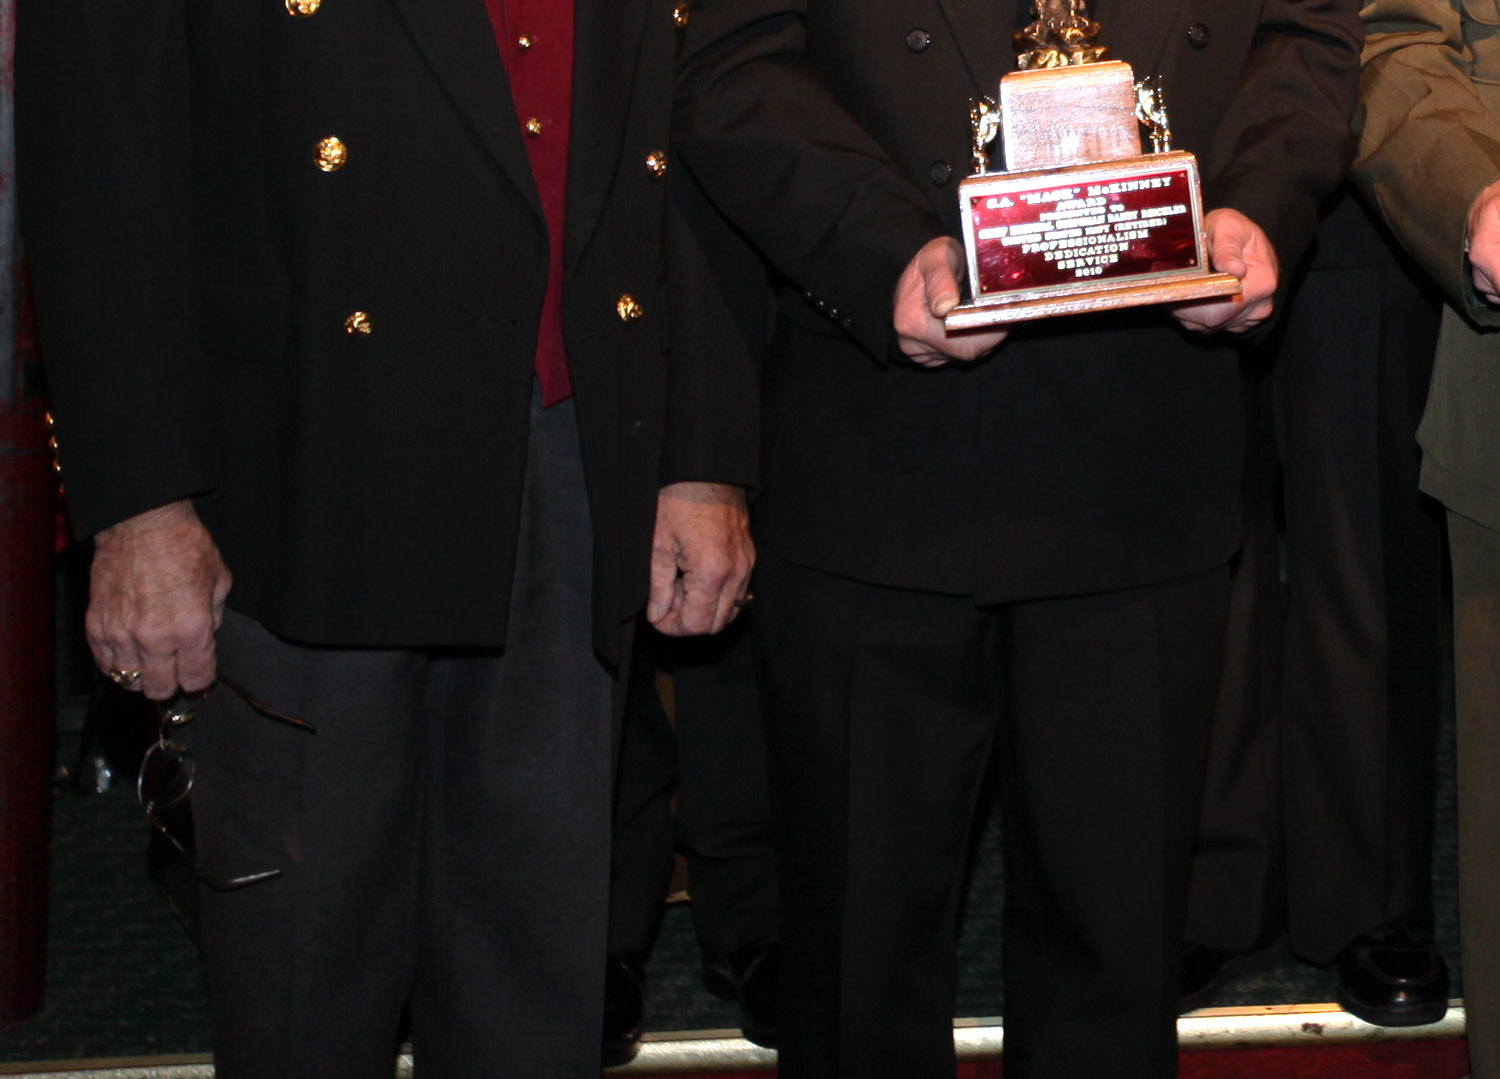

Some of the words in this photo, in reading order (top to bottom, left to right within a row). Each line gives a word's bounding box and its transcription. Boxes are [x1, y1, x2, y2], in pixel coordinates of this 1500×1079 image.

[1056, 196, 1107, 212] AWARD
[1021, 229, 1149, 254] PROFESSIONALISM
[1044, 242, 1129, 262] DEDICATION
[1057, 253, 1119, 270] SERVICE
[1074, 266, 1103, 278] 2010
